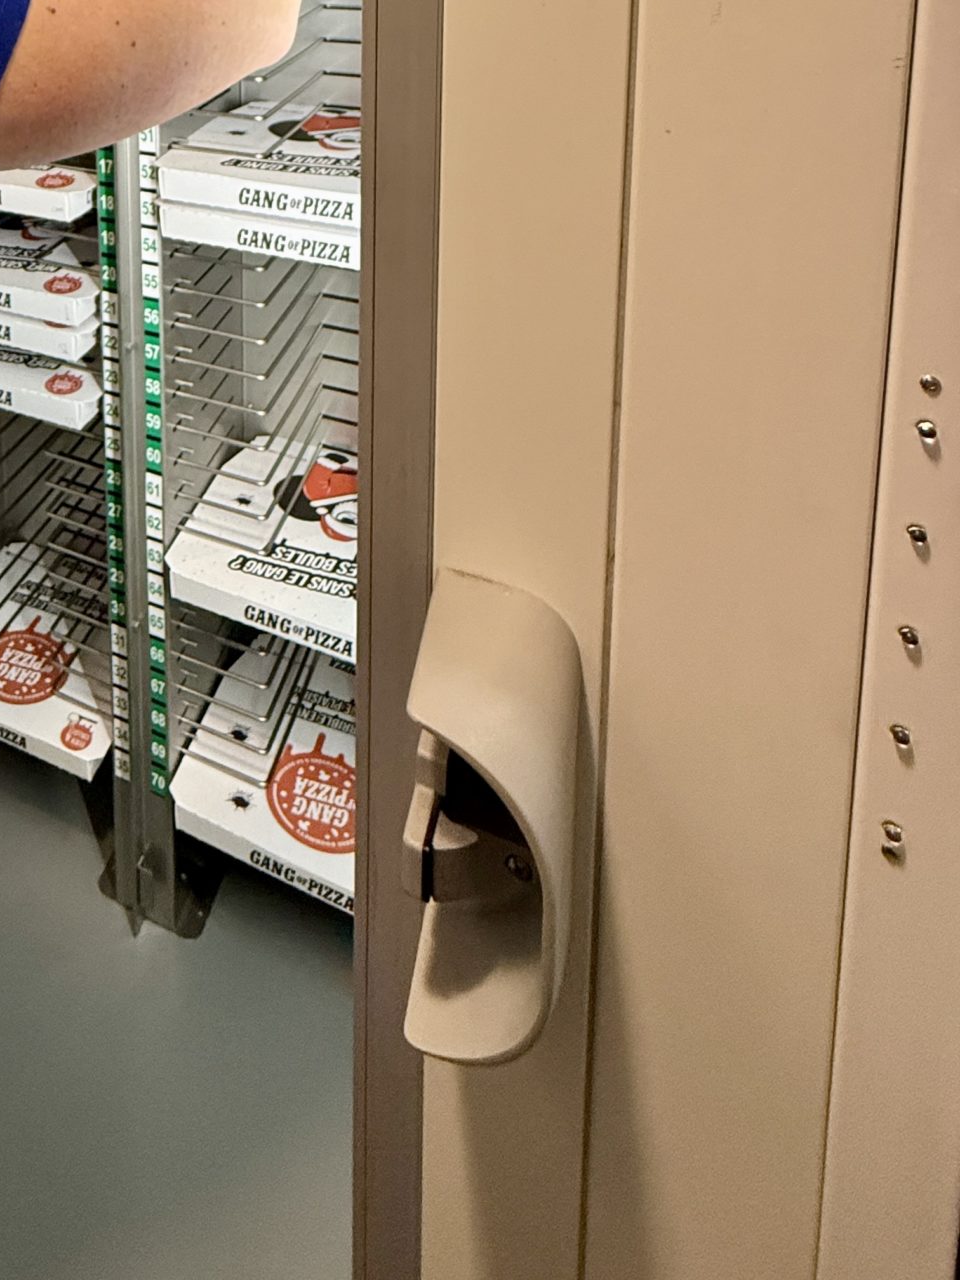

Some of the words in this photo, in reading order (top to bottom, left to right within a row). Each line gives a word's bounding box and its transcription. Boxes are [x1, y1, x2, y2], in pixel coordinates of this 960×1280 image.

[99, 158, 112, 174] 17
[141, 164, 157, 180] 52
[100, 195, 114, 210] 18
[142, 201, 157, 217] 53
[239, 188, 288, 210] GANG
[303, 196, 354, 220] PIZZA
[101, 230, 115, 246] 19
[143, 238, 157, 252] 54
[237, 229, 286, 252] GANG
[300, 238, 351, 263] PIZZA
[102, 265, 116, 281] 20
[144, 274, 158, 288] 55
[103, 300, 116, 316] 21
[144, 308, 159, 325] 56
[104, 335, 117, 350] 22
[145, 344, 160, 360] 57
[105, 369, 118, 384] 23
[145, 378, 160, 395] 58
[106, 404, 118, 418] 24
[146, 413, 161, 430] 59
[107, 437, 120, 452] 25
[146, 448, 161, 464] 60
[147, 482, 160, 497] 61
[108, 502, 122, 518] 27
[148, 516, 161, 531] 62
[148, 548, 162, 563] 63
[272, 546, 337, 571] BOULES
[242, 560, 288, 581] GANG
[286, 570, 309, 586] LE
[149, 582, 162, 596] 64
[308, 576, 354, 597] SANS
[150, 614, 164, 630] 65
[244, 605, 290, 634] GANG
[304, 627, 352, 657] PIZZA
[0, 648, 46, 670] PIZZA
[150, 646, 165, 663] 66
[150, 679, 165, 694] 67
[151, 710, 166, 727] 68
[151, 742, 166, 758] 69
[151, 772, 166, 790] 70
[293, 776, 349, 806] PIZZA
[291, 796, 349, 828] GANG
[249, 850, 296, 883] GANG
[308, 877, 354, 911] PIZZA
